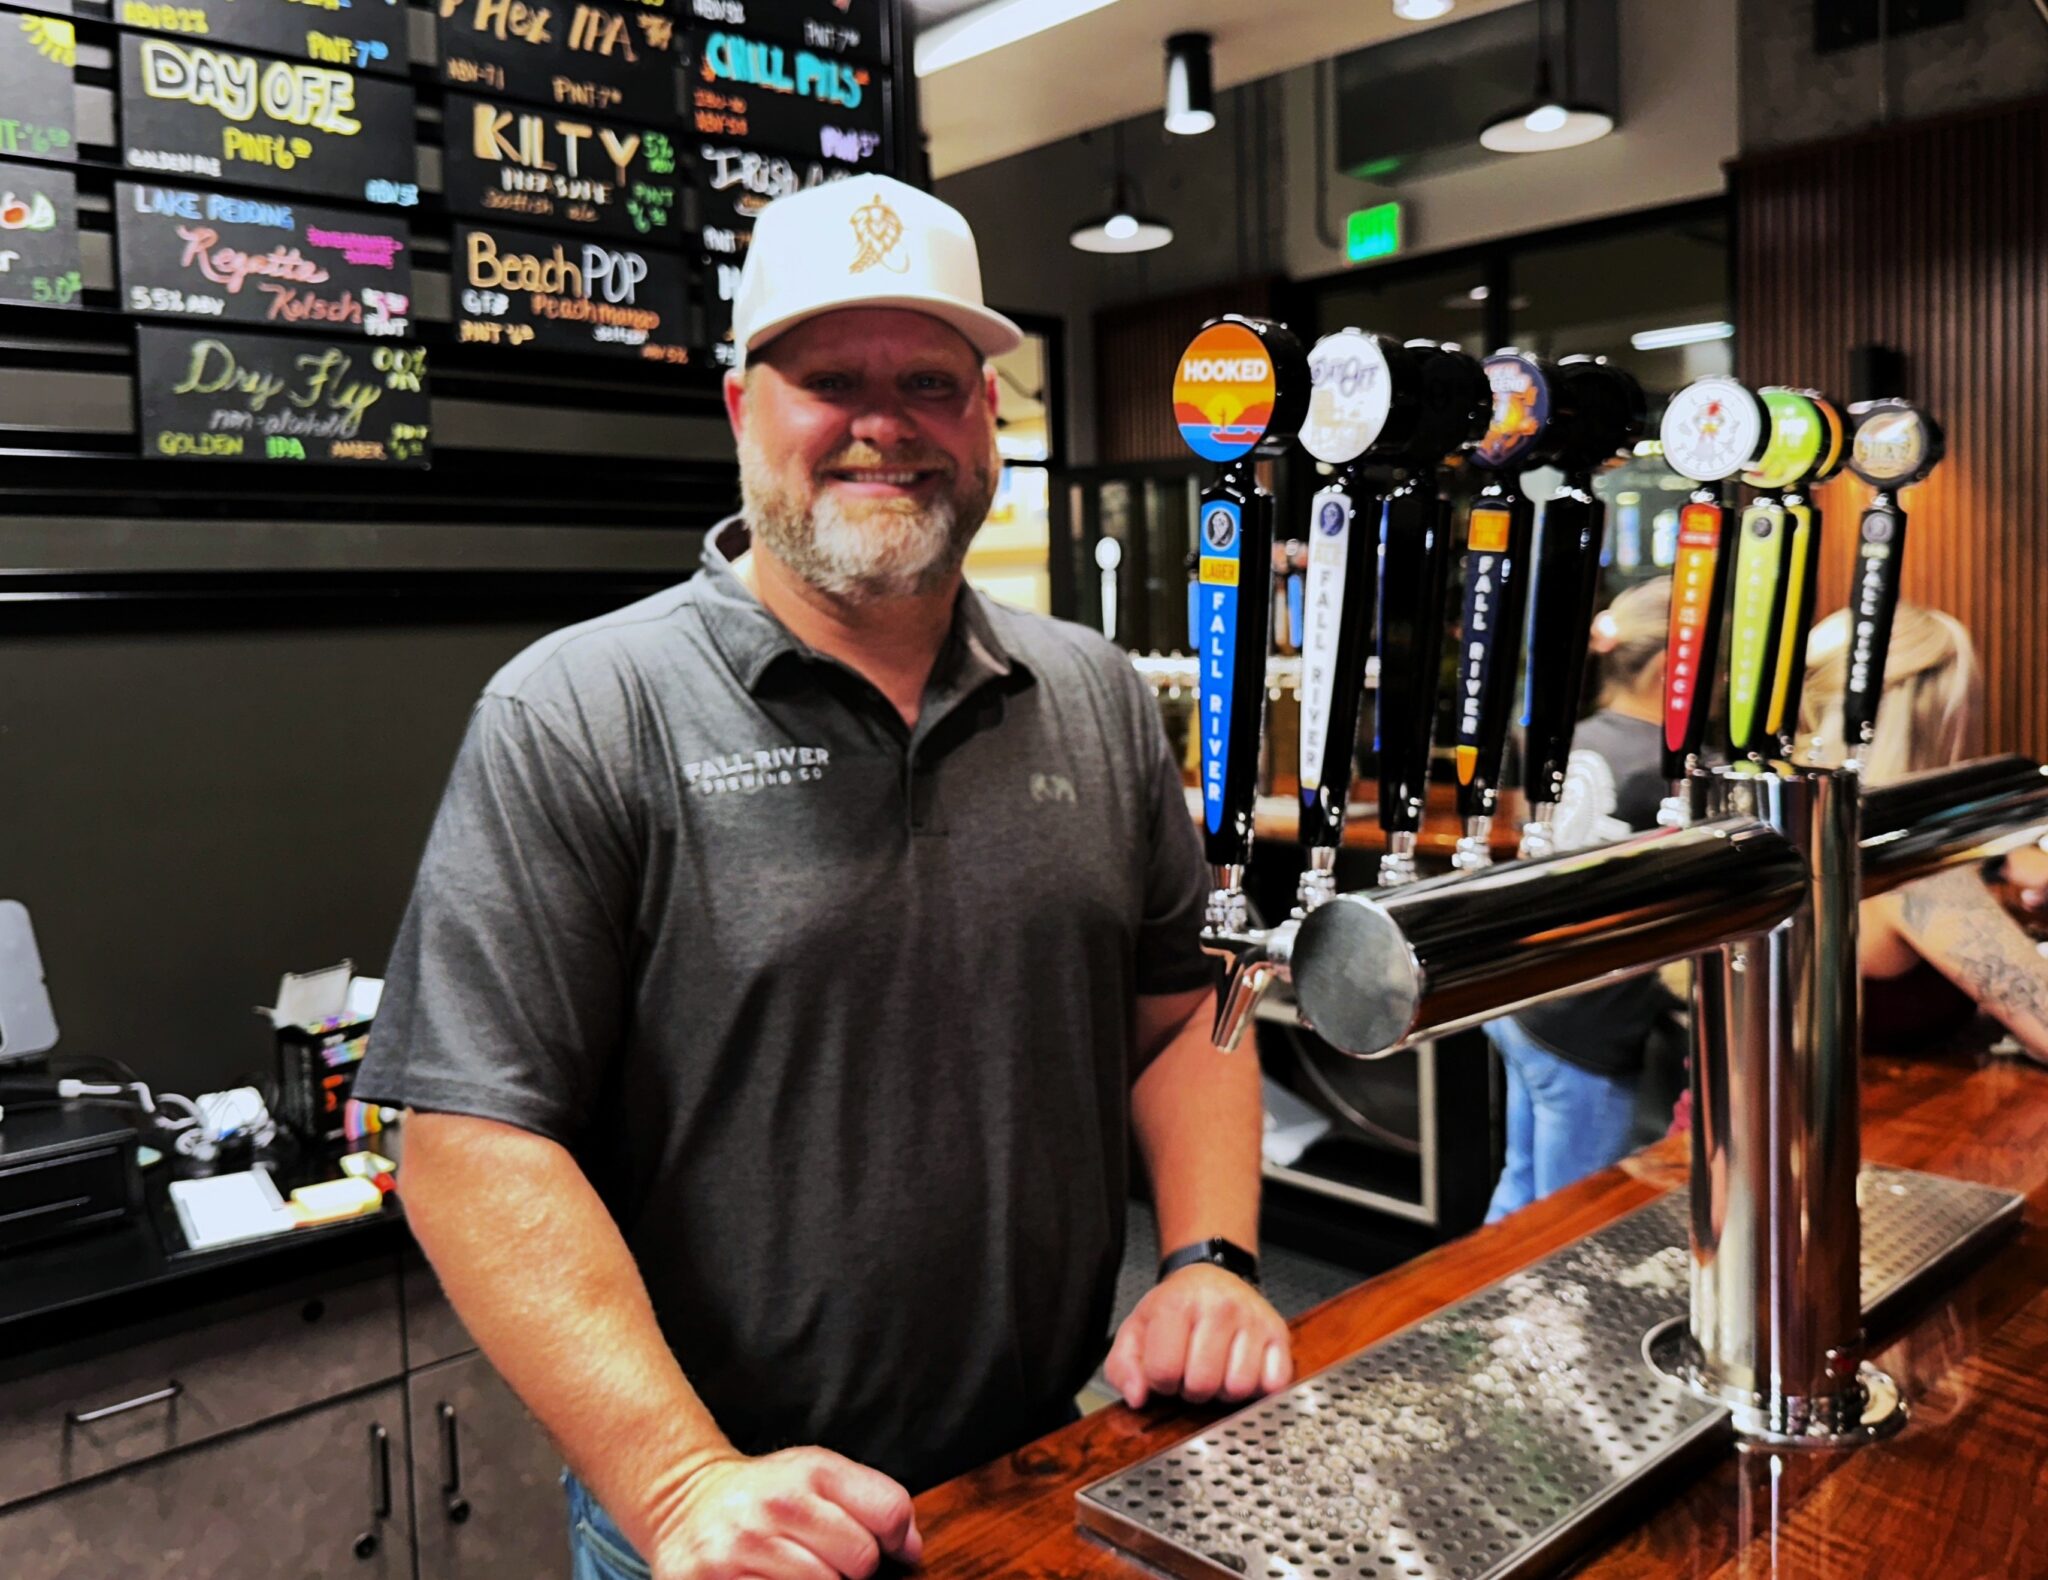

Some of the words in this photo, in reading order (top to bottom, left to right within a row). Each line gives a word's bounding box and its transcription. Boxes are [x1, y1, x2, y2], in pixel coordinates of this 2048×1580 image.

[141, 39, 258, 121] DAY
[706, 32, 794, 90] CHILL
[794, 51, 862, 109] PILS
[472, 102, 641, 188] KILTY
[133, 183, 202, 221] LAKE
[207, 191, 296, 231] REDDING
[466, 231, 583, 298] Beach
[581, 243, 649, 304] POP
[172, 338, 284, 411] Dry
[1184, 358, 1268, 382] HOOKED
[157, 430, 244, 456] GOLDEN
[265, 435, 307, 460] IPA
[1203, 562, 1236, 582] LAGER
[1315, 570, 1331, 650] FALL
[1472, 555, 1494, 631] FALL
[1210, 591, 1226, 679] FALL
[1306, 667, 1322, 767] RIVER
[1461, 641, 1485, 735] RIVER
[683, 753, 754, 784] FALL
[753, 746, 829, 770] RIVER
[1208, 693, 1223, 801] RIVER
